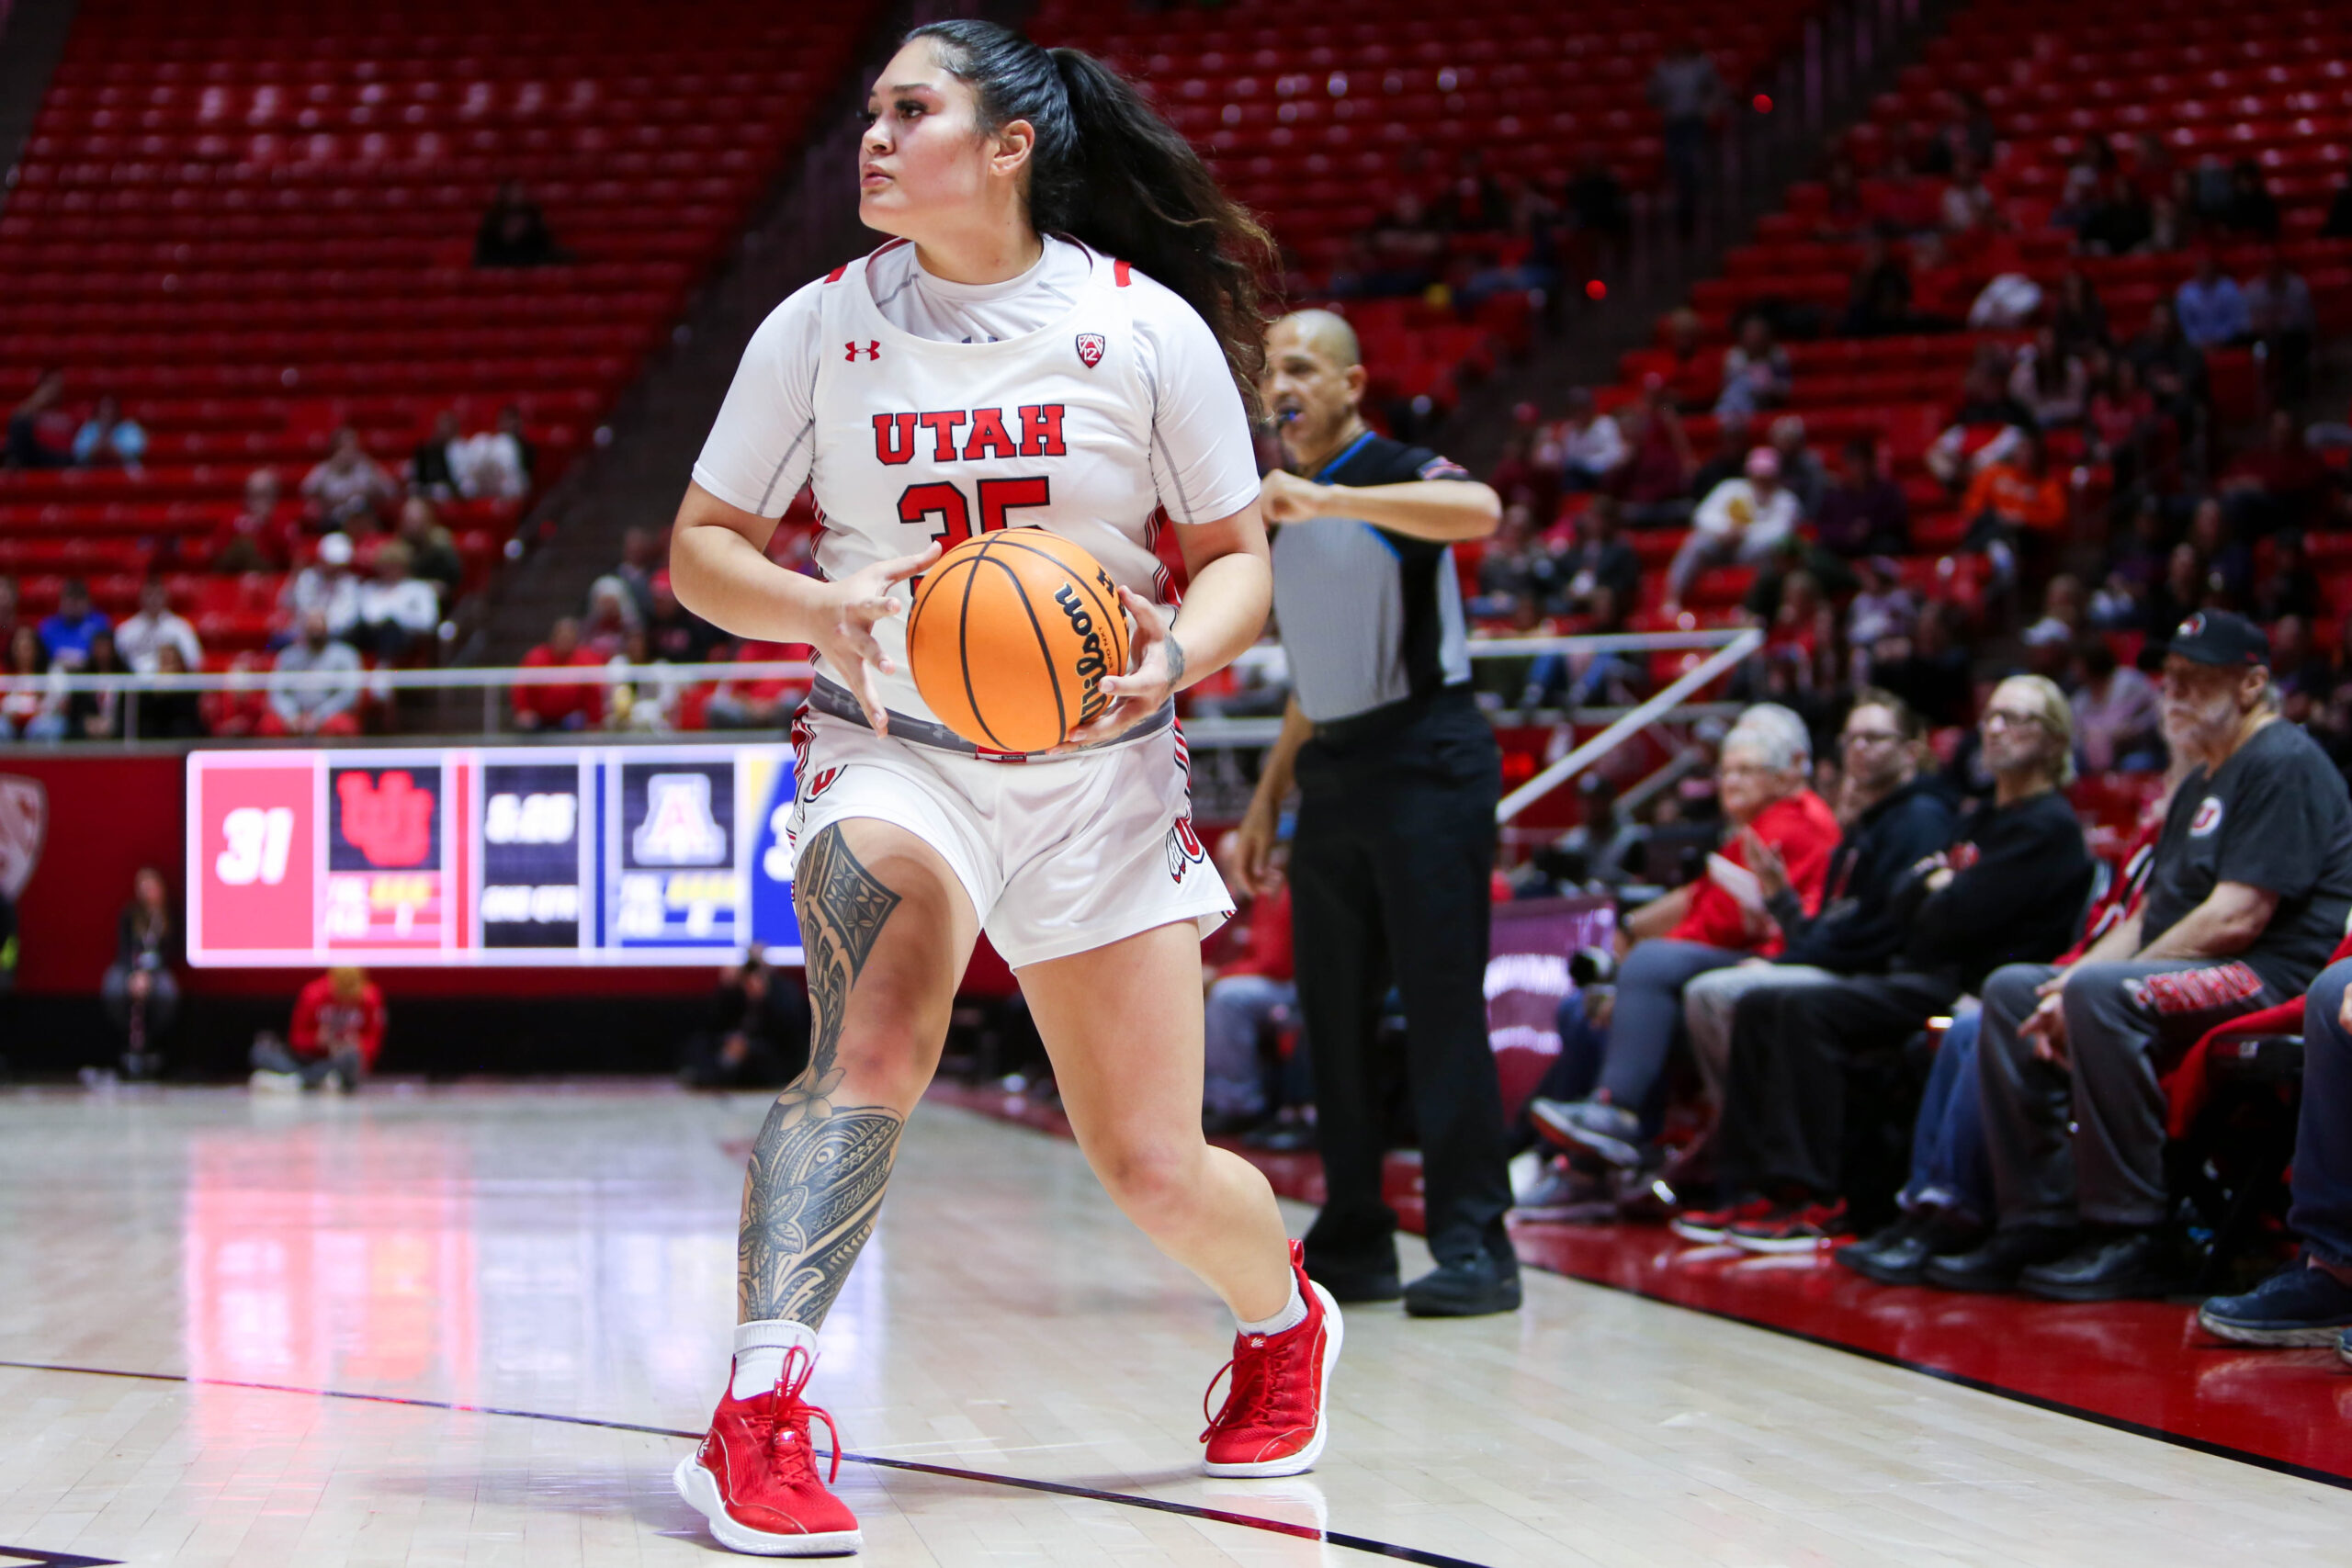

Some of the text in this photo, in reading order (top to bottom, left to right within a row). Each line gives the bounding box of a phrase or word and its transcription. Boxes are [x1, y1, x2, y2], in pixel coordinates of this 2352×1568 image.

[1084, 347, 1099, 361] 12
[872, 404, 1067, 466] UTAH
[216, 807, 294, 885] 31
